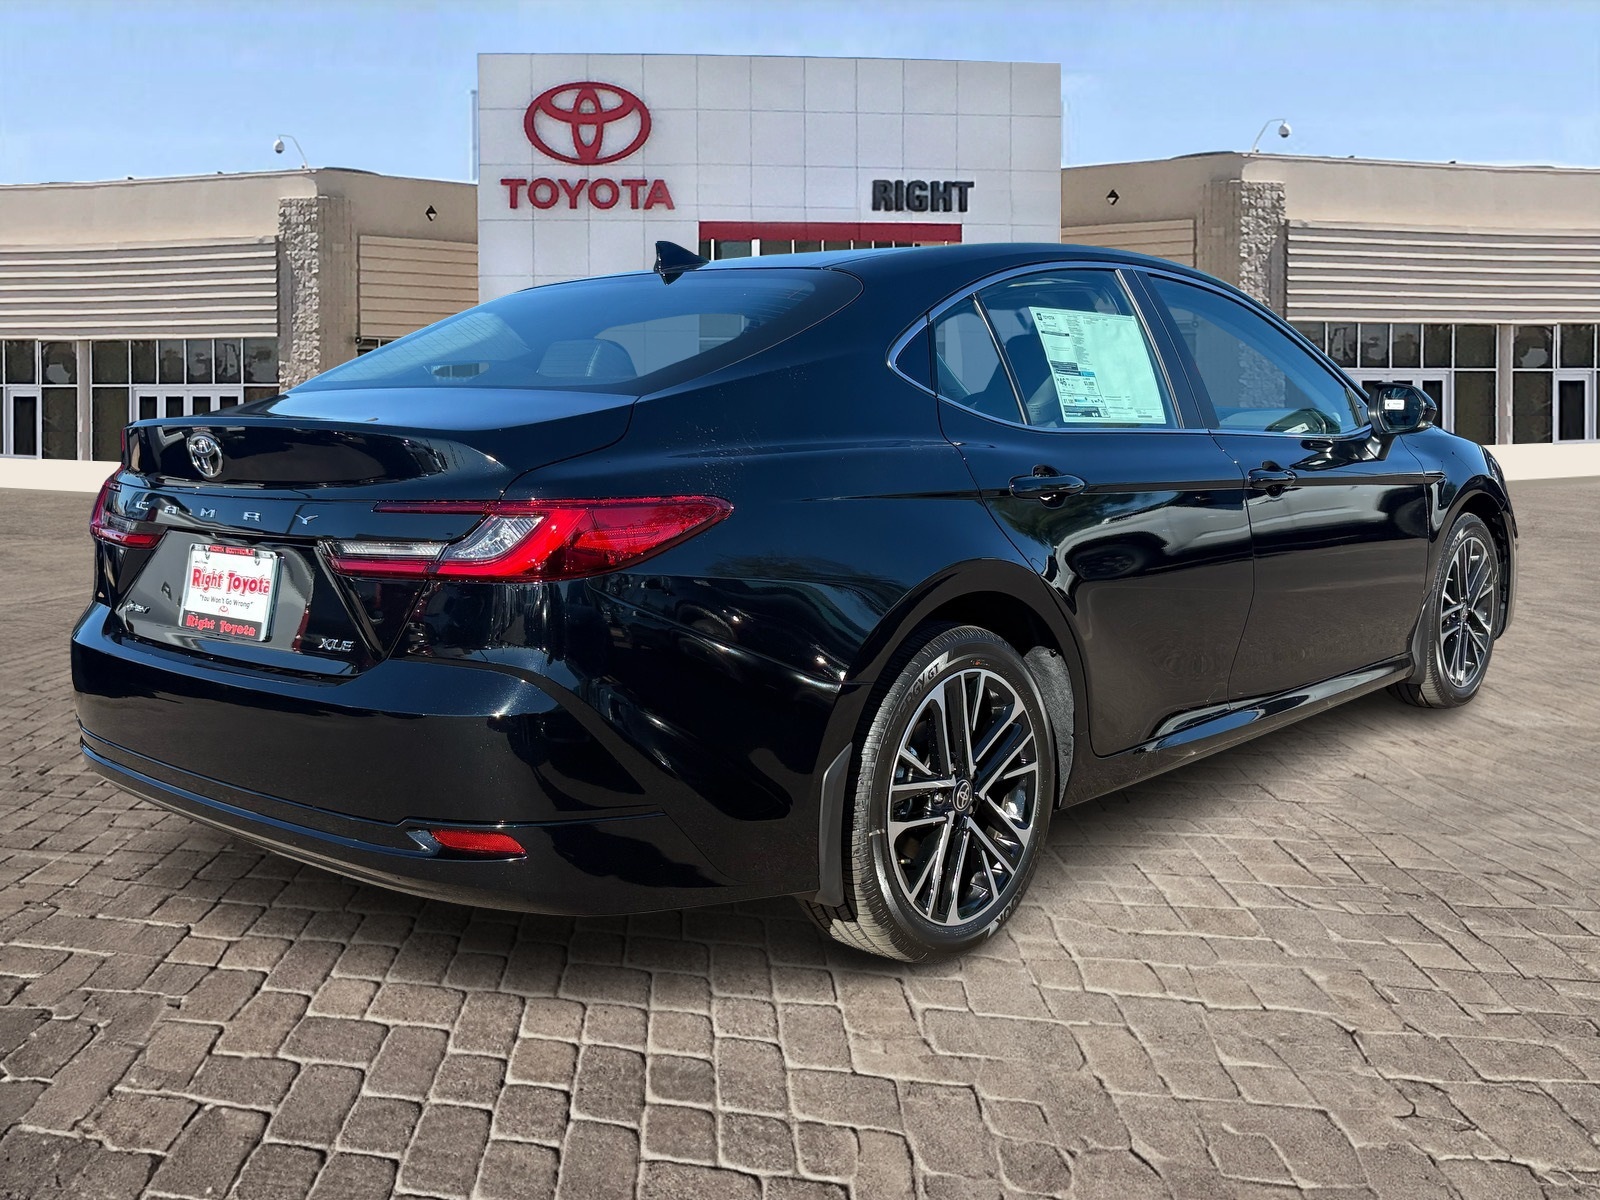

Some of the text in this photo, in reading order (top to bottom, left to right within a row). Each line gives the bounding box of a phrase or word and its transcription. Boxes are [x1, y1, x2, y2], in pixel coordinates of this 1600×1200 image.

[500, 178, 675, 210] TOYOTA
[871, 179, 975, 212] RIGHT
[136, 501, 319, 525] CAMRY
[192, 567, 270, 595] Right Toyota
[211, 596, 225, 604] Won't
[233, 600, 253, 609] Wrong"
[186, 615, 256, 636] Right Toyota
[318, 637, 354, 651] XLE
